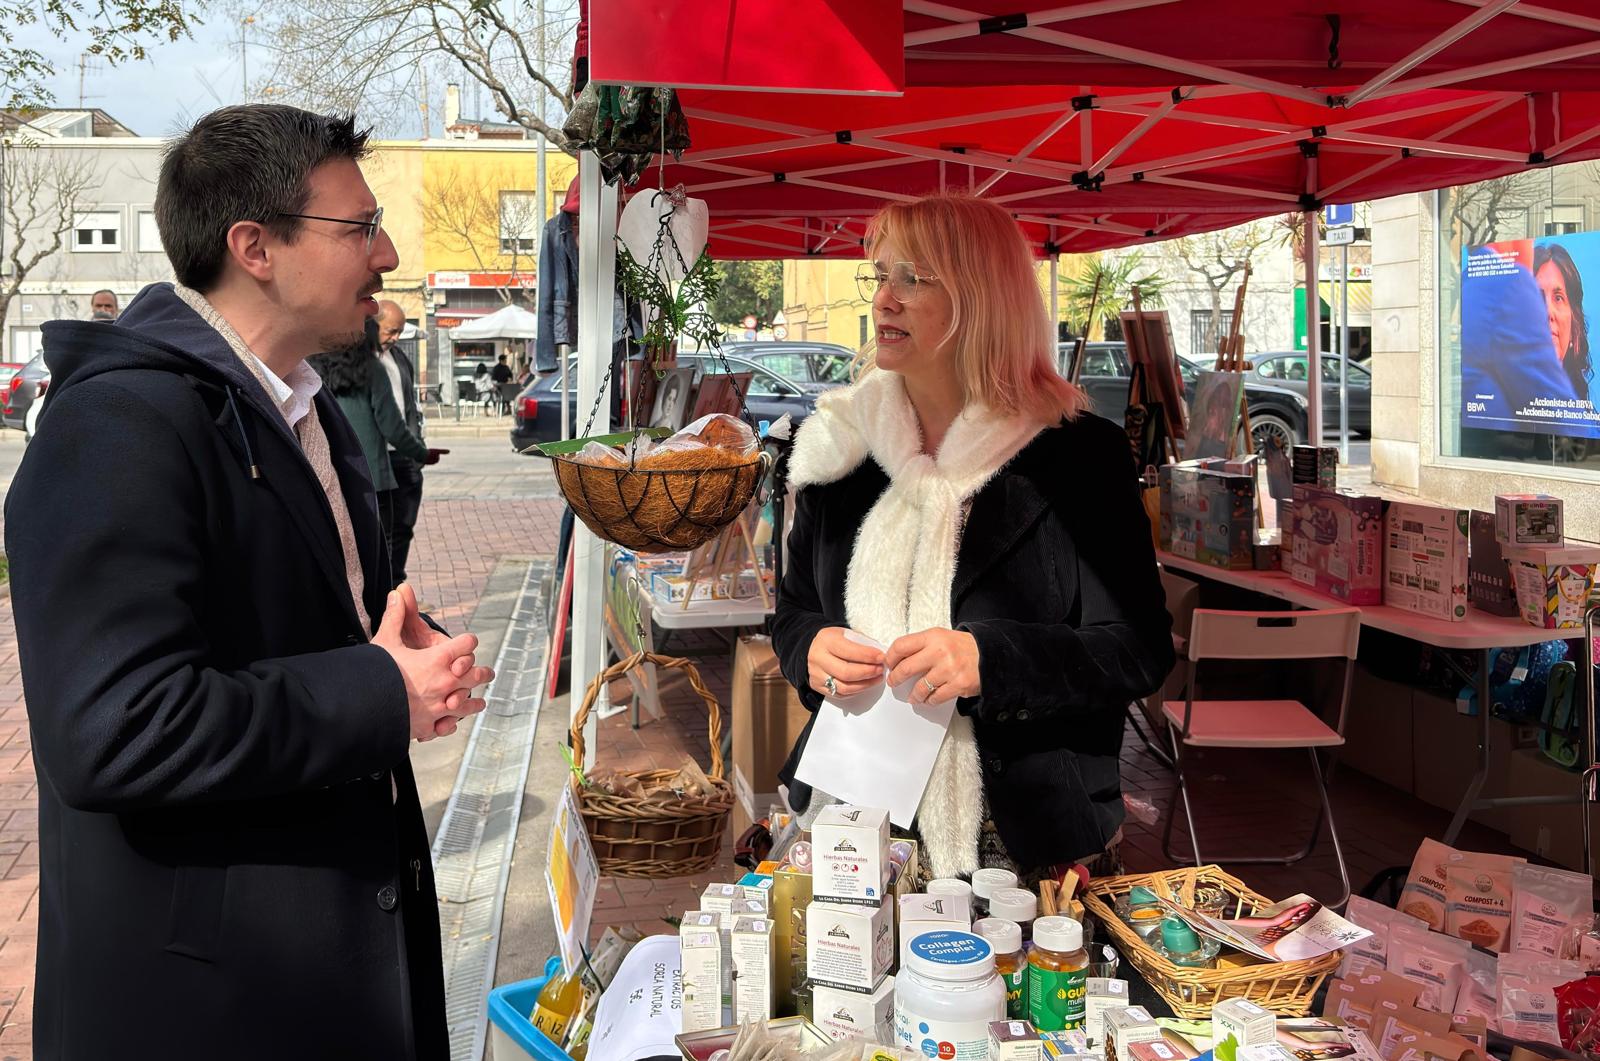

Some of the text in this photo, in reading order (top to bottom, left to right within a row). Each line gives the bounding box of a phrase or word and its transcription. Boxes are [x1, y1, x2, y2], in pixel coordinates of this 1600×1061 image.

[1333, 232, 1346, 240] TAXI
[1467, 402, 1485, 412] BBVA
[1534, 398, 1566, 407] Accionistas
[1576, 400, 1593, 409] BBVA
[1523, 408, 1554, 417] Accionistas
[1556, 410, 1563, 418] de
[1564, 410, 1582, 419] Banco
[1419, 876, 1445, 890] COMPOST
[1465, 896, 1493, 905] COMPOST
[919, 938, 975, 950] Collagen
[929, 946, 976, 955] Complet
[650, 963, 665, 1017] SORIA NATURAL
[671, 970, 681, 1009] EXTRACTOS
